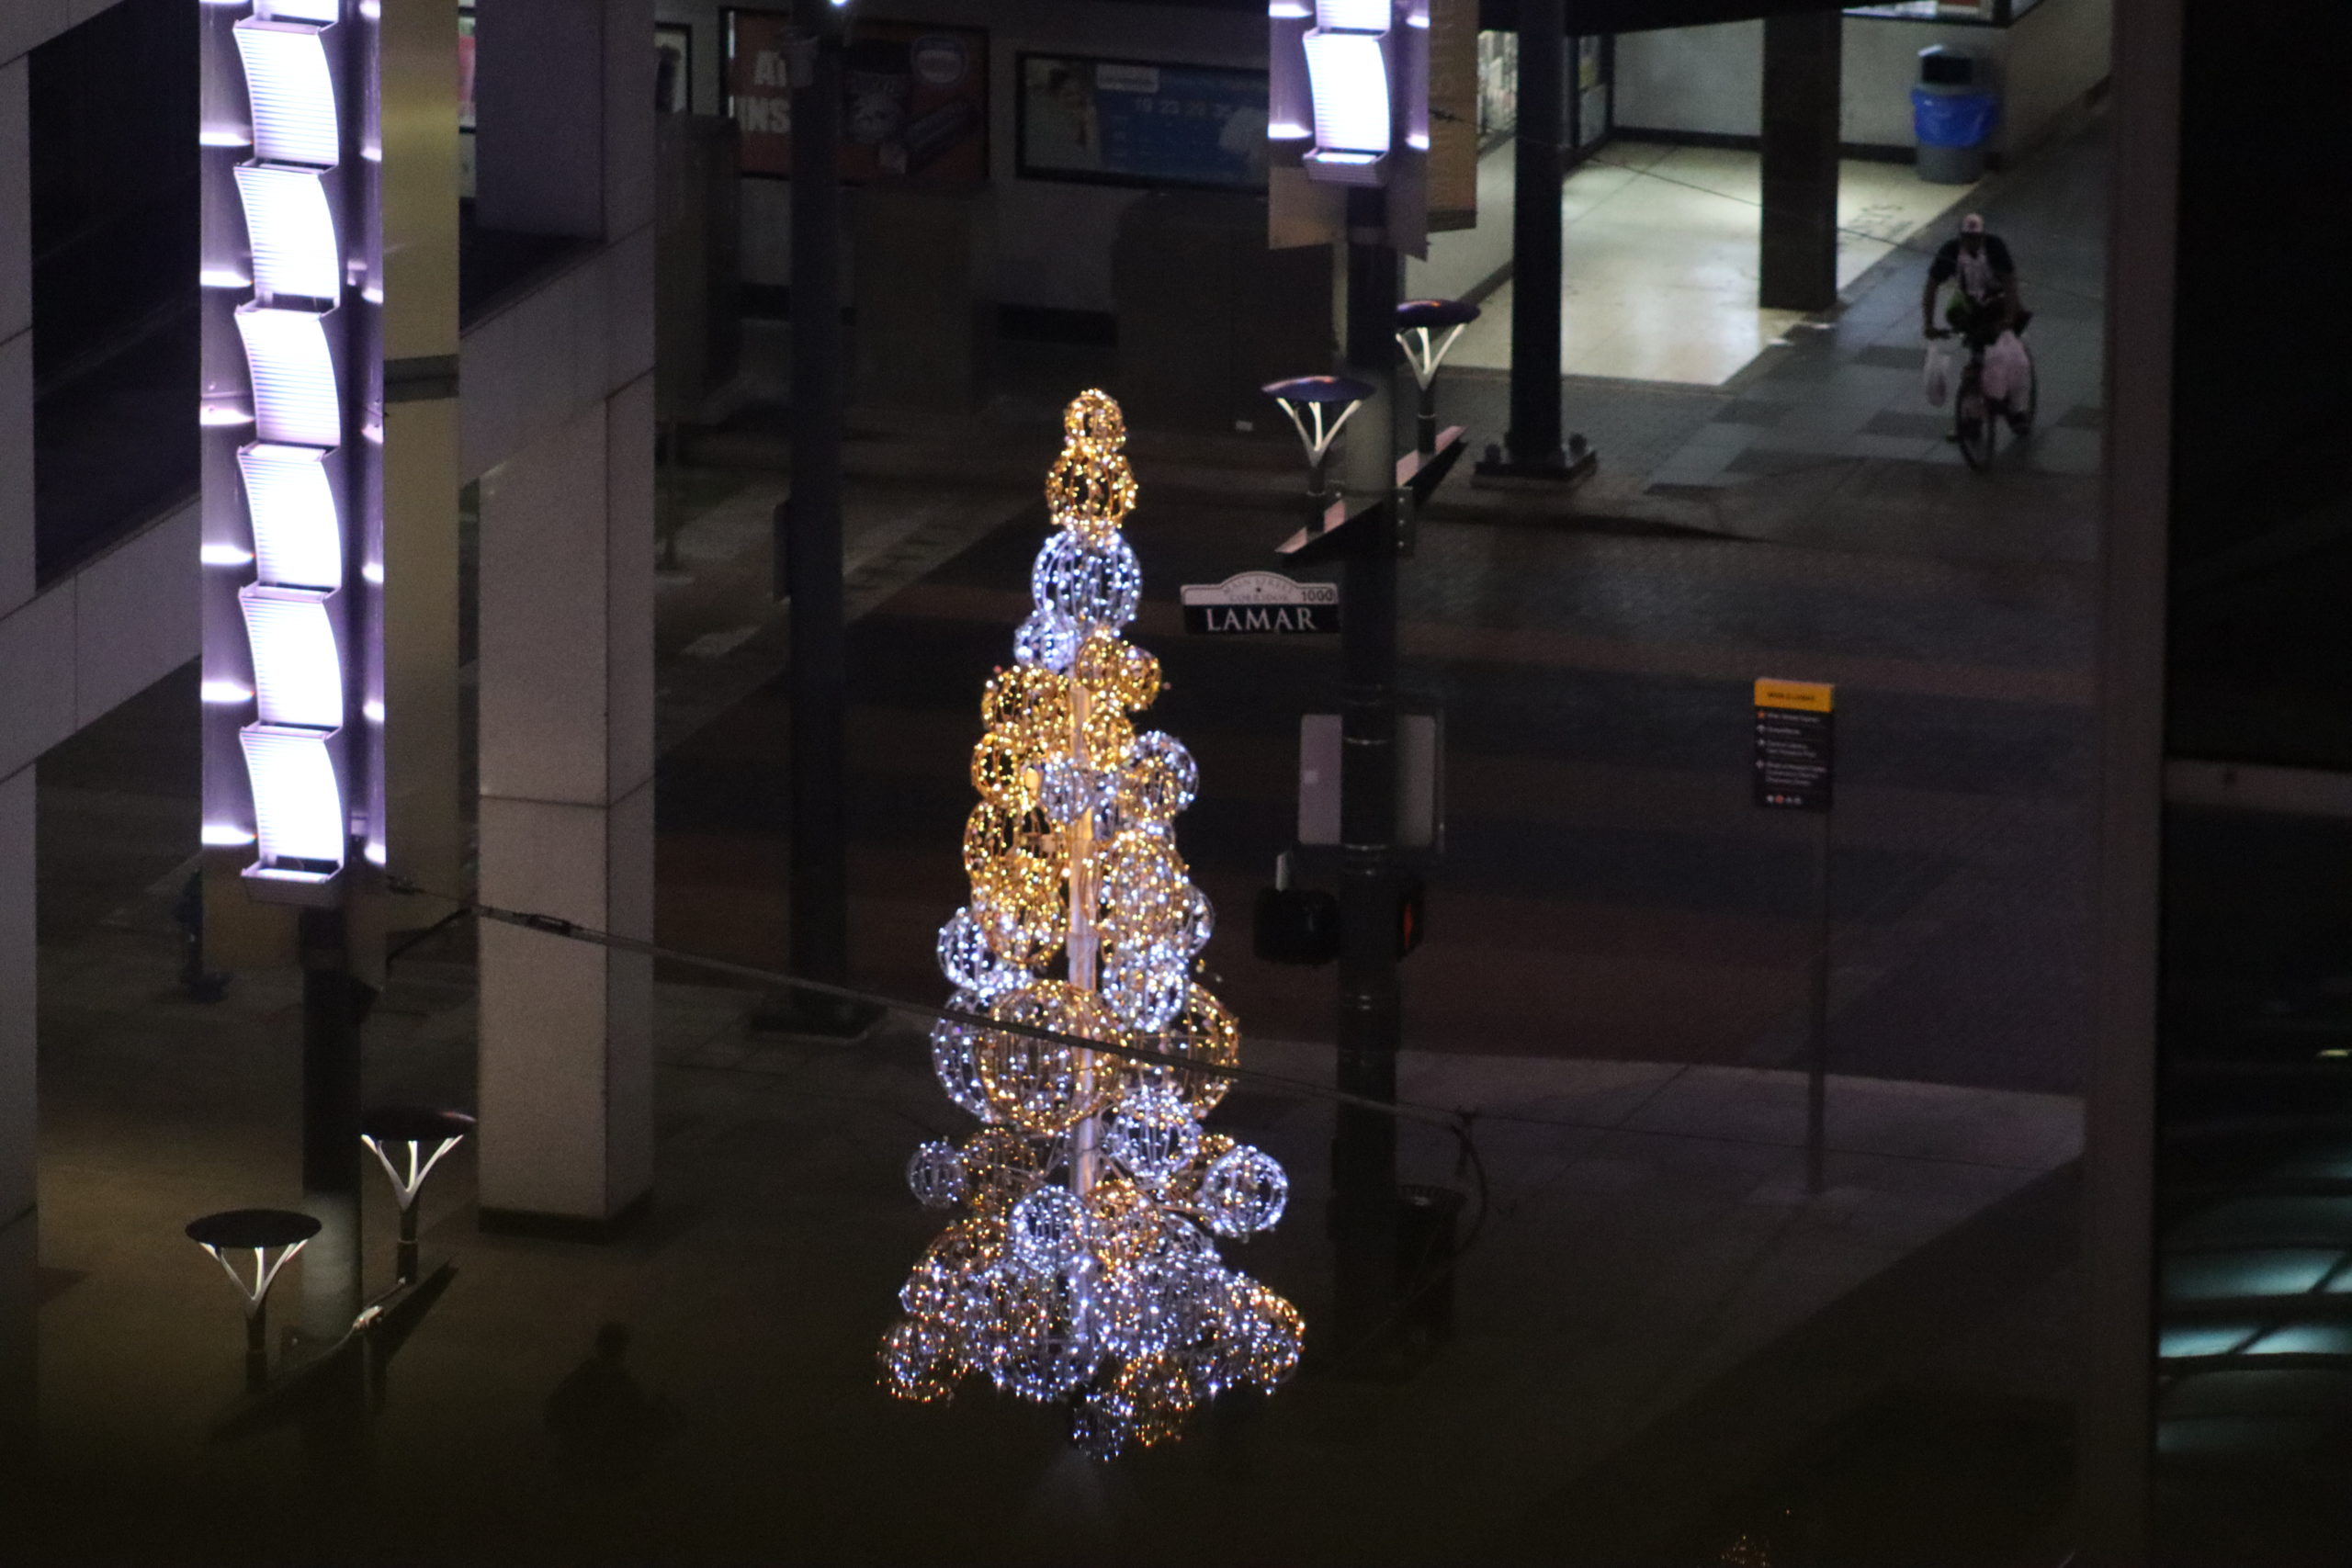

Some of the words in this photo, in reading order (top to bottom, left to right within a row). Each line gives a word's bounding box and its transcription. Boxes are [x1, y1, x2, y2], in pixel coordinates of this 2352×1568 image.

[735, 96, 791, 133] INS
[1301, 590, 1333, 602] 1000
[1206, 607, 1317, 631] LAMAR
